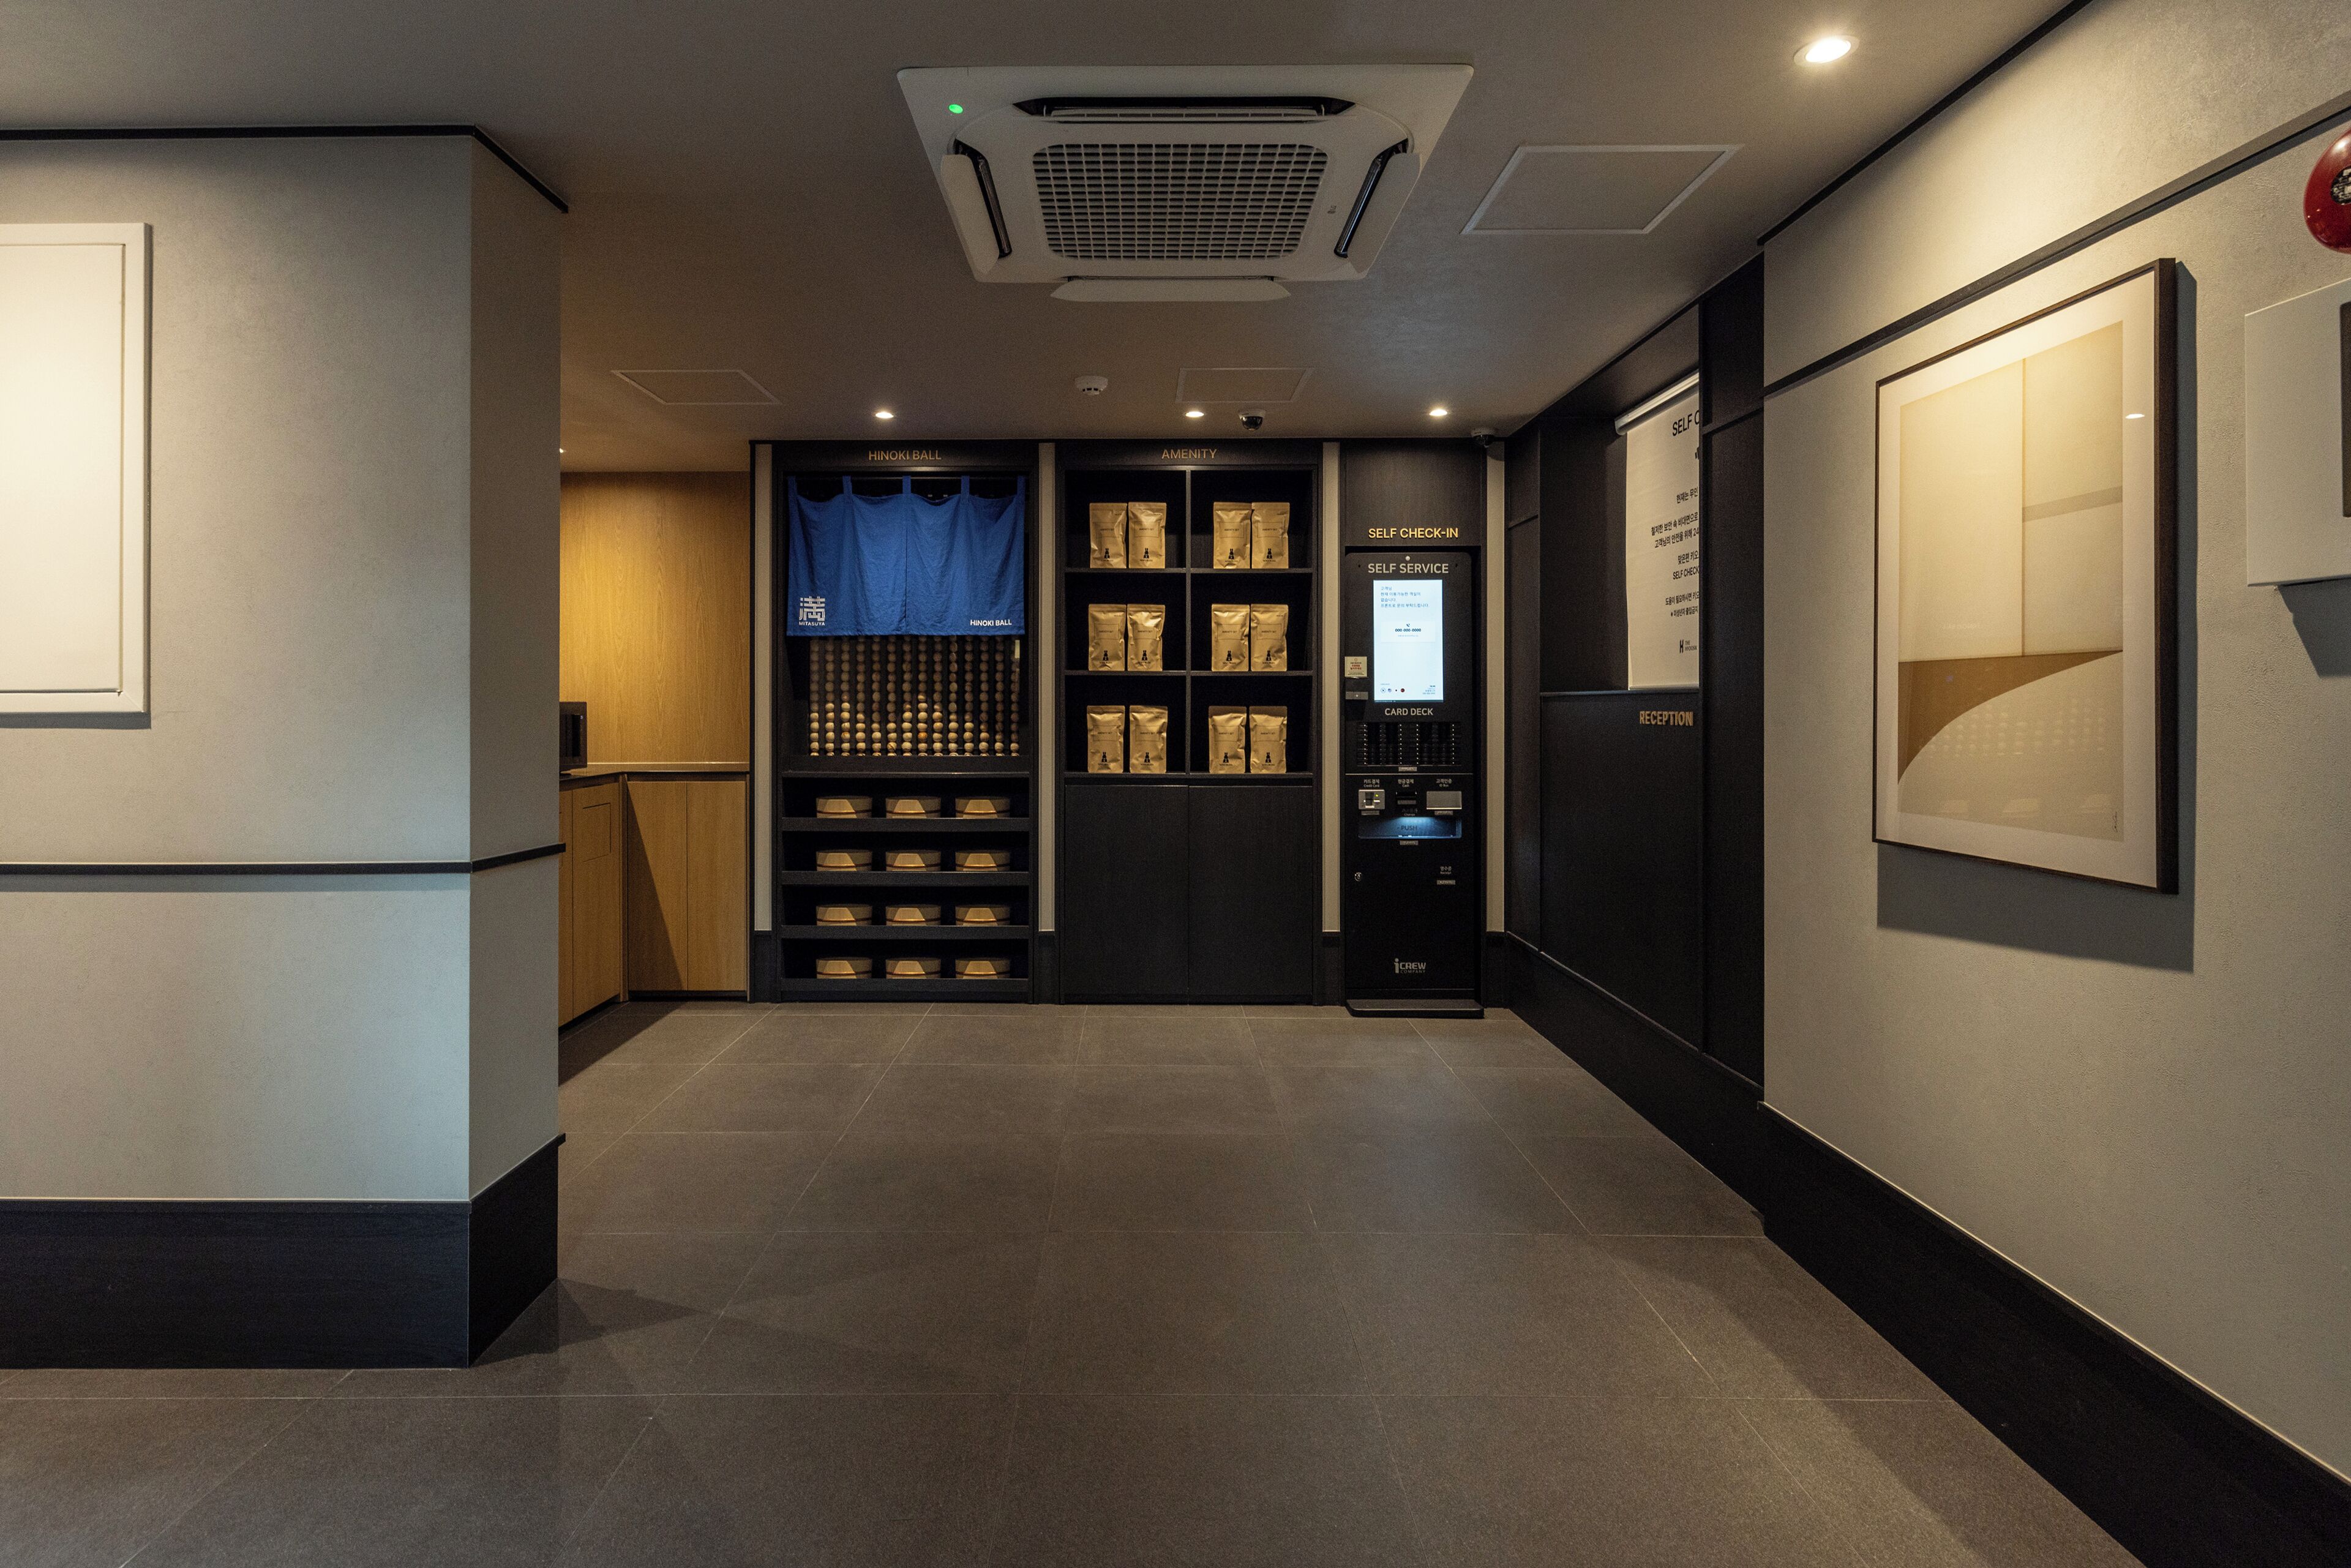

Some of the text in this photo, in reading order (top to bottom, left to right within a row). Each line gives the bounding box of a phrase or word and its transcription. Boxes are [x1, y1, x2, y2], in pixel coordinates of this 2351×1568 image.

[1673, 413, 1692, 436] SELF
[869, 450, 942, 460] HINOKI BALL
[1161, 449, 1217, 459] AMENITY
[1676, 487, 1698, 504] 현재는 무인
[1651, 512, 1698, 536] 철저한 보안 속 비대면으로
[1368, 528, 1459, 539] SELF CHECK-IN
[1654, 535, 1671, 548] 고객님의
[1671, 531, 1683, 544] 안전을
[1684, 530, 1692, 540] 위해
[1678, 553, 1690, 565] 맞은편
[1368, 563, 1449, 574] SELF SERVICE
[1673, 570, 1684, 580] SELF
[1665, 597, 1675, 606] 도움이
[1676, 593, 1692, 603] 필요하시면
[1685, 606, 1698, 615] 출입금지
[1640, 710, 1693, 726] RECEPTION
